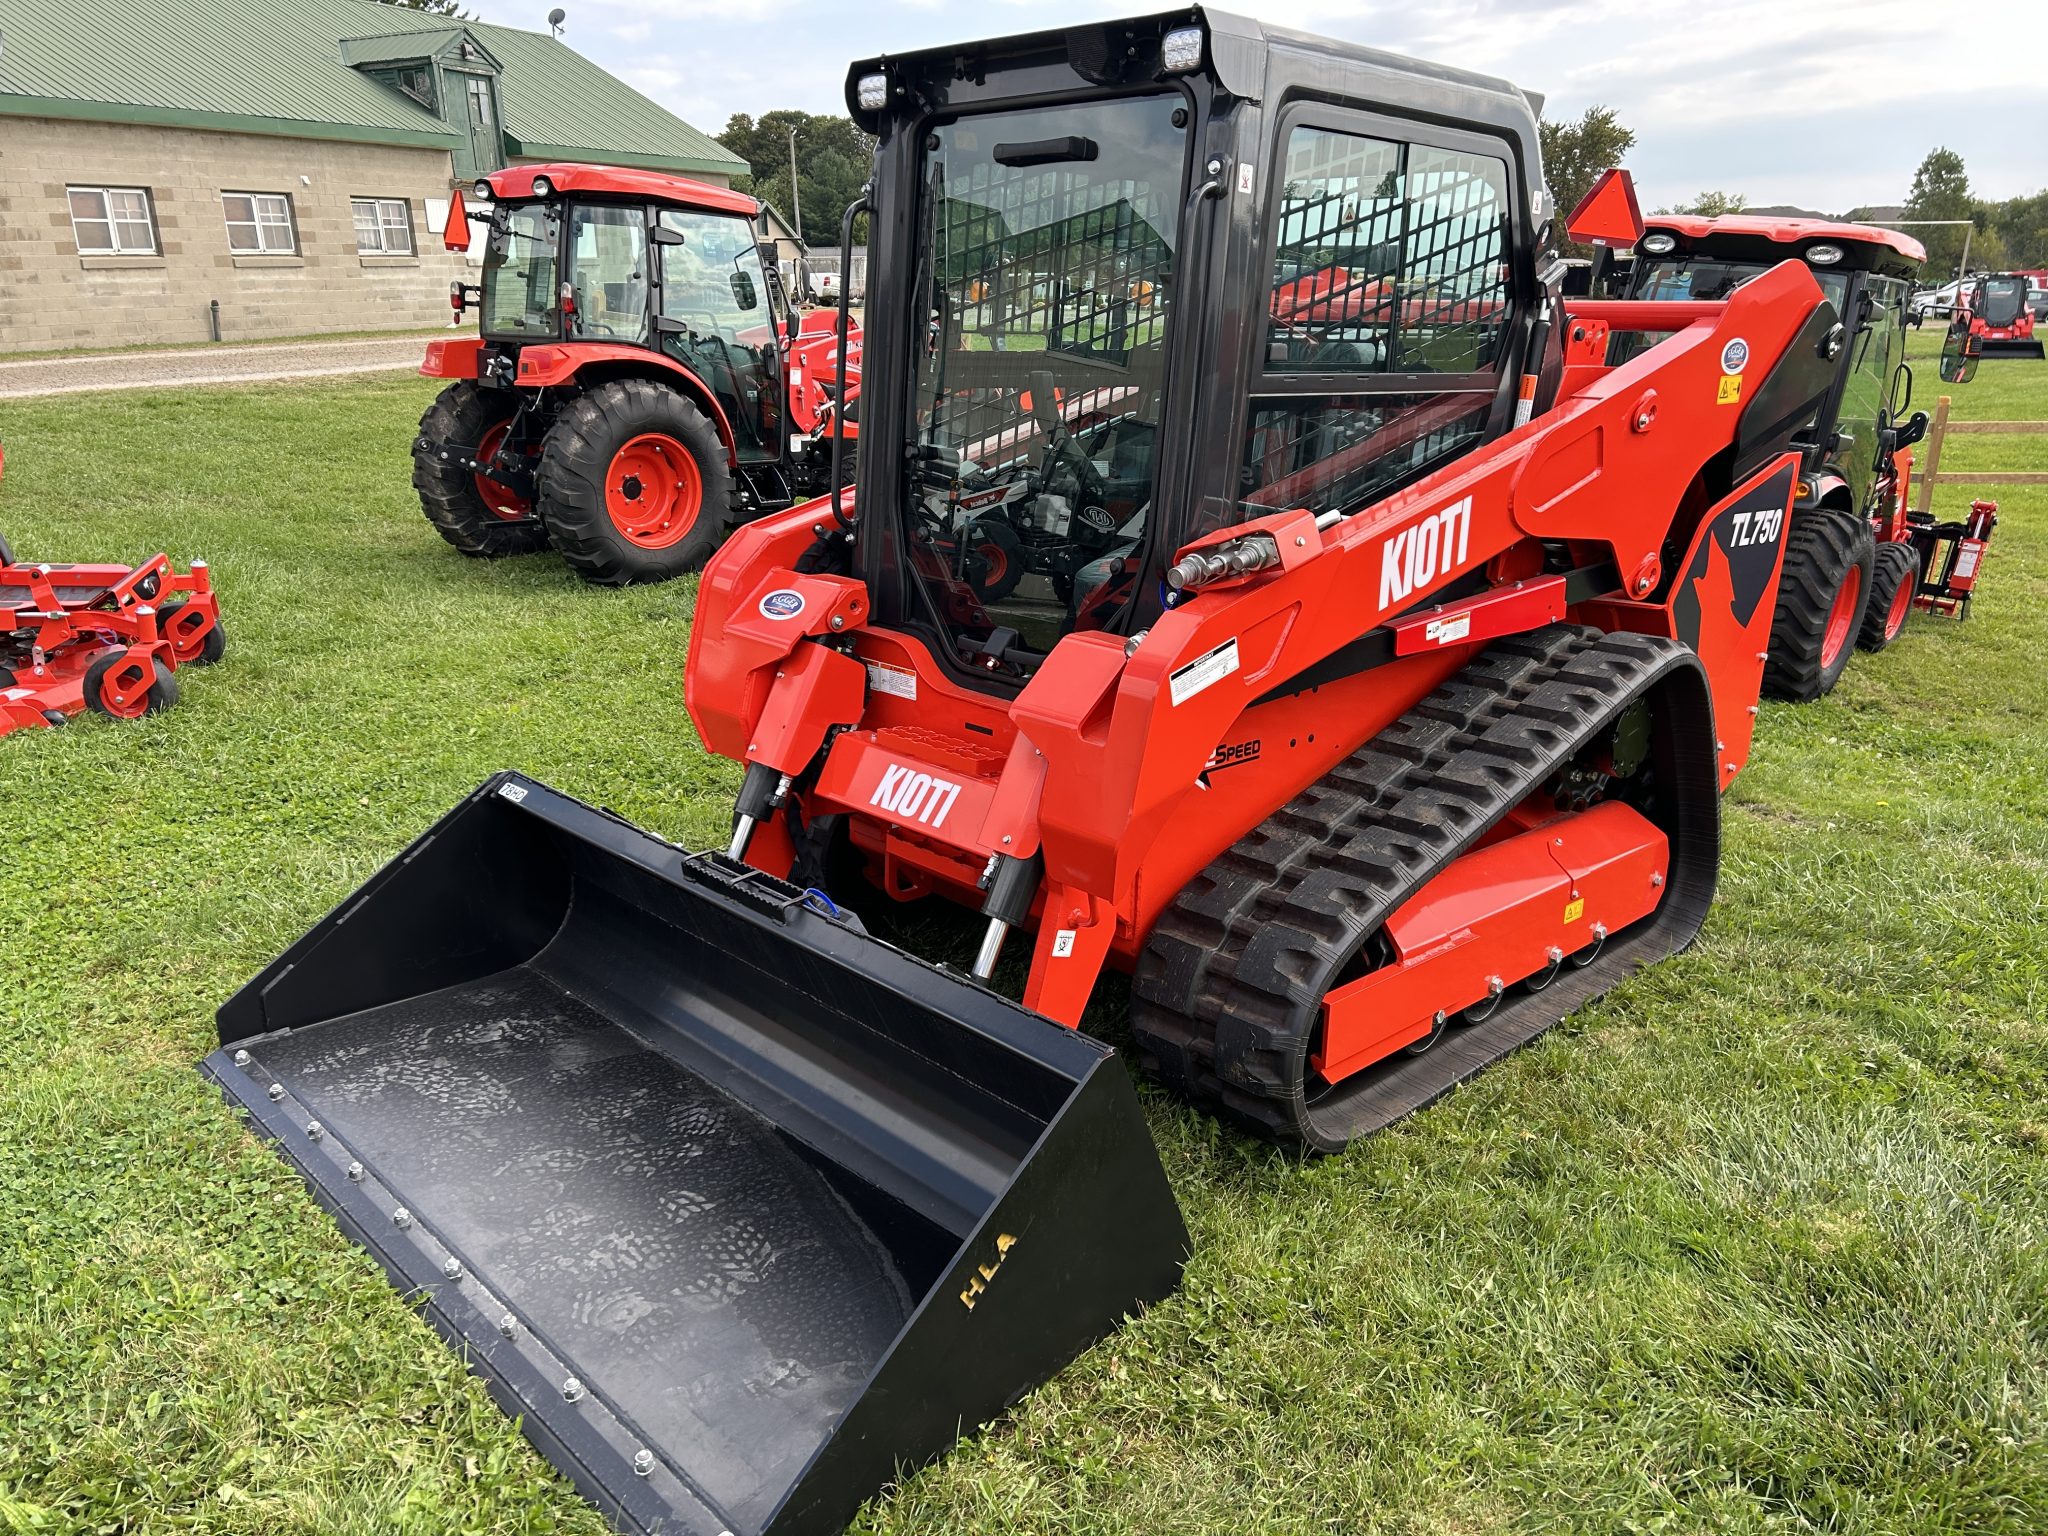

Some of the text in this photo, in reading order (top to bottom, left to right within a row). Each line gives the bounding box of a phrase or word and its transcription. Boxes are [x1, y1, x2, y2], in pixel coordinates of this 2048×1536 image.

[1378, 494, 1473, 612] KIOTI
[1730, 508, 1783, 548] TL750
[771, 595, 799, 610] EGGER
[500, 784, 525, 800] 78HD
[869, 763, 962, 829] KIOTI
[960, 1232, 1018, 1311] HLA
